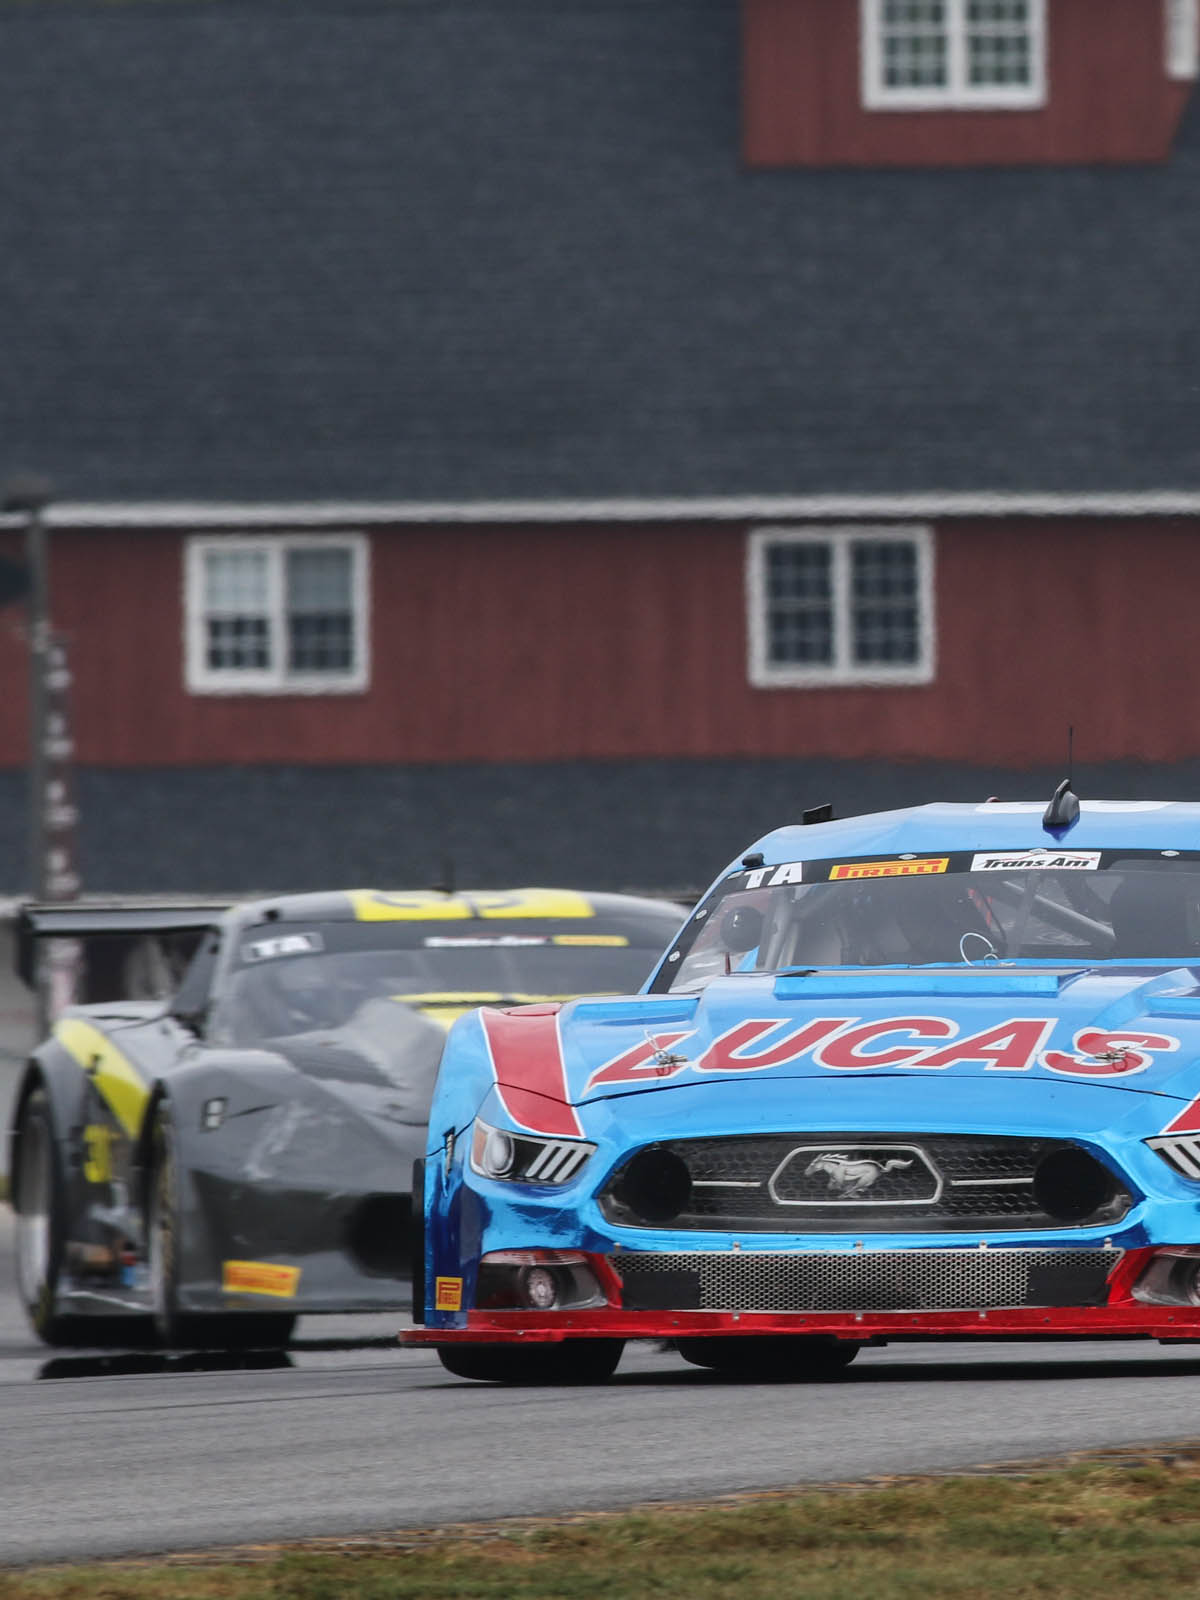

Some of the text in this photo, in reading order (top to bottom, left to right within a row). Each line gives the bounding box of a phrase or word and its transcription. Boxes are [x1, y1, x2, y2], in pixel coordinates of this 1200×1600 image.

[837, 860, 942, 878] PIRELLI
[983, 857, 1090, 868] Trans Am
[744, 862, 802, 889] TA
[580, 1016, 1178, 1096] LUCAS
